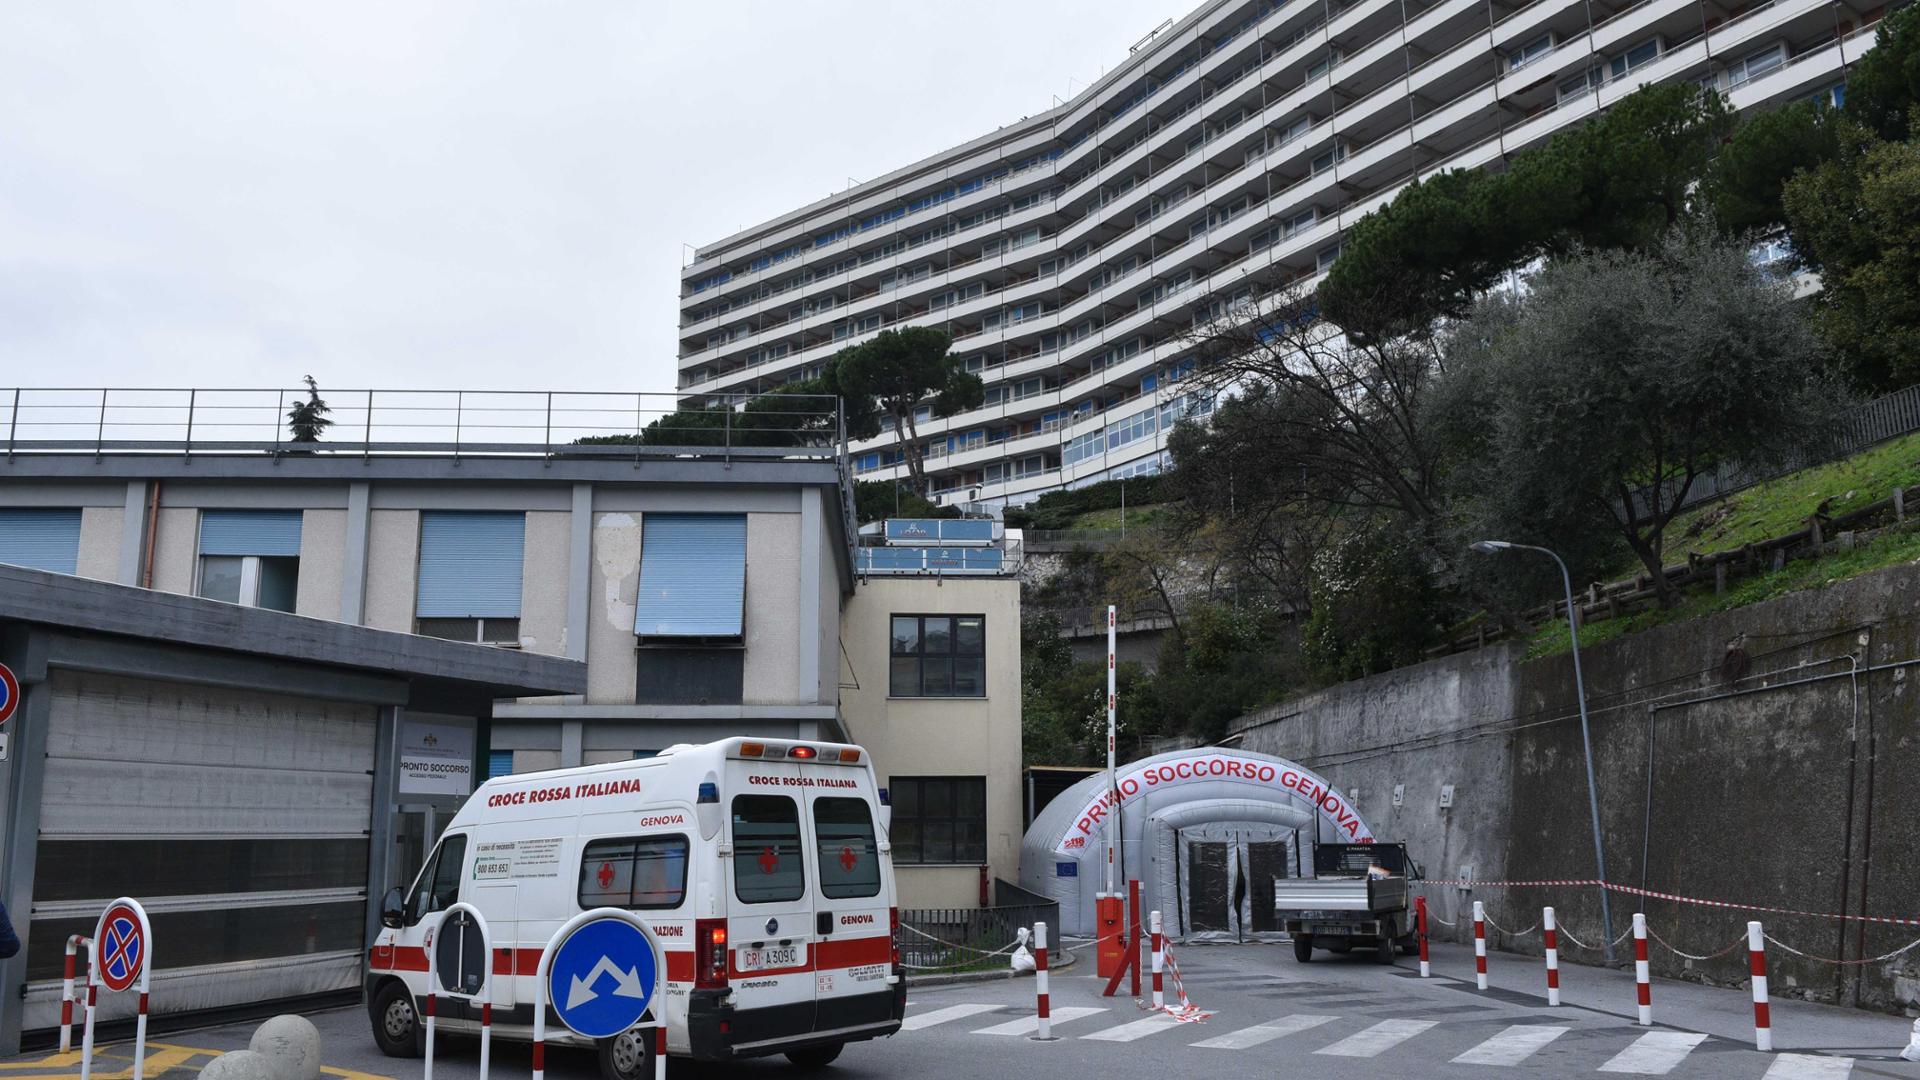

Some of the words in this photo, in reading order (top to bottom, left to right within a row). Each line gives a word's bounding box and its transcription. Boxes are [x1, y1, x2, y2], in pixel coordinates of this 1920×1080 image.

[400, 762, 429, 772] PRONTO
[430, 763, 470, 774] SOCCORSO
[748, 775, 780, 786] CROCE
[783, 777, 814, 787] ROSSA
[816, 778, 857, 788] ITALIANA
[488, 791, 526, 807] CROCE
[529, 786, 571, 804] ROSSA
[575, 778, 641, 798] ITALIANA
[1077, 778, 1139, 836] PRIMO
[1143, 759, 1275, 786] SOCCORSO
[1281, 771, 1360, 838] GENOVA
[640, 814, 684, 827] GENOVA
[841, 914, 874, 925] GENOVA
[745, 951, 761, 967] CRI
